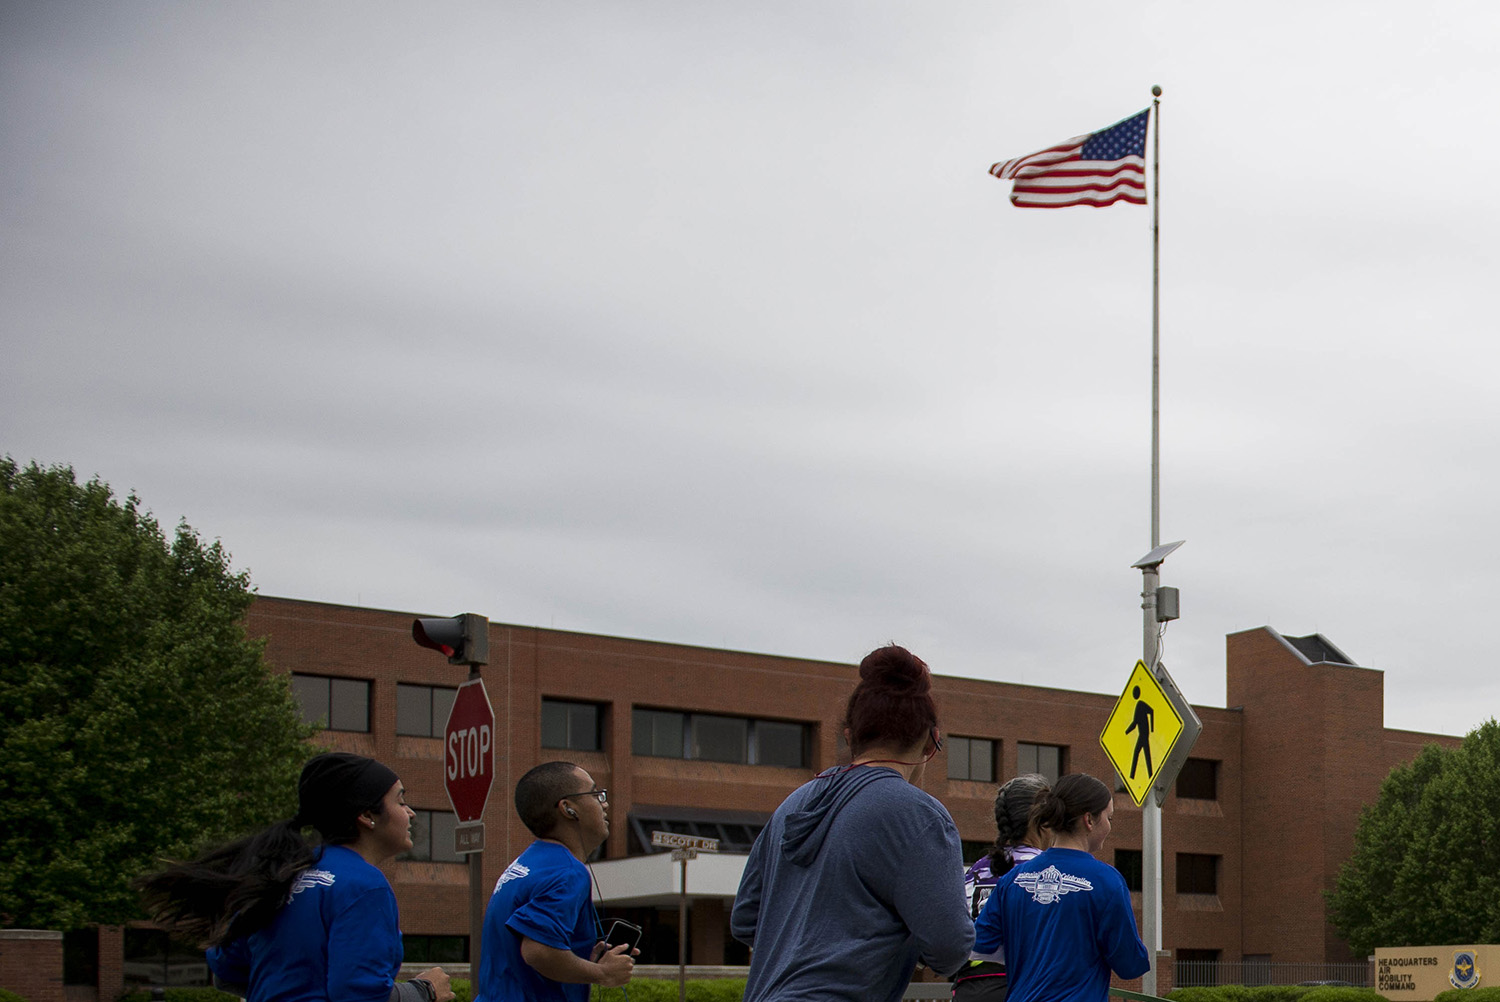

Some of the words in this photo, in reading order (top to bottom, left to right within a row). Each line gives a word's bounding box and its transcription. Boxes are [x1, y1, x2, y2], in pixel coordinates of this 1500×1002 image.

[448, 724, 490, 781] STOP
[662, 834, 698, 848] SCOTT
[1378, 957, 1438, 967] HEADQUARTERS
[1378, 966, 1391, 974] AIR
[1378, 974, 1412, 982] MOBILITY
[1378, 982, 1416, 991] COMMAND
